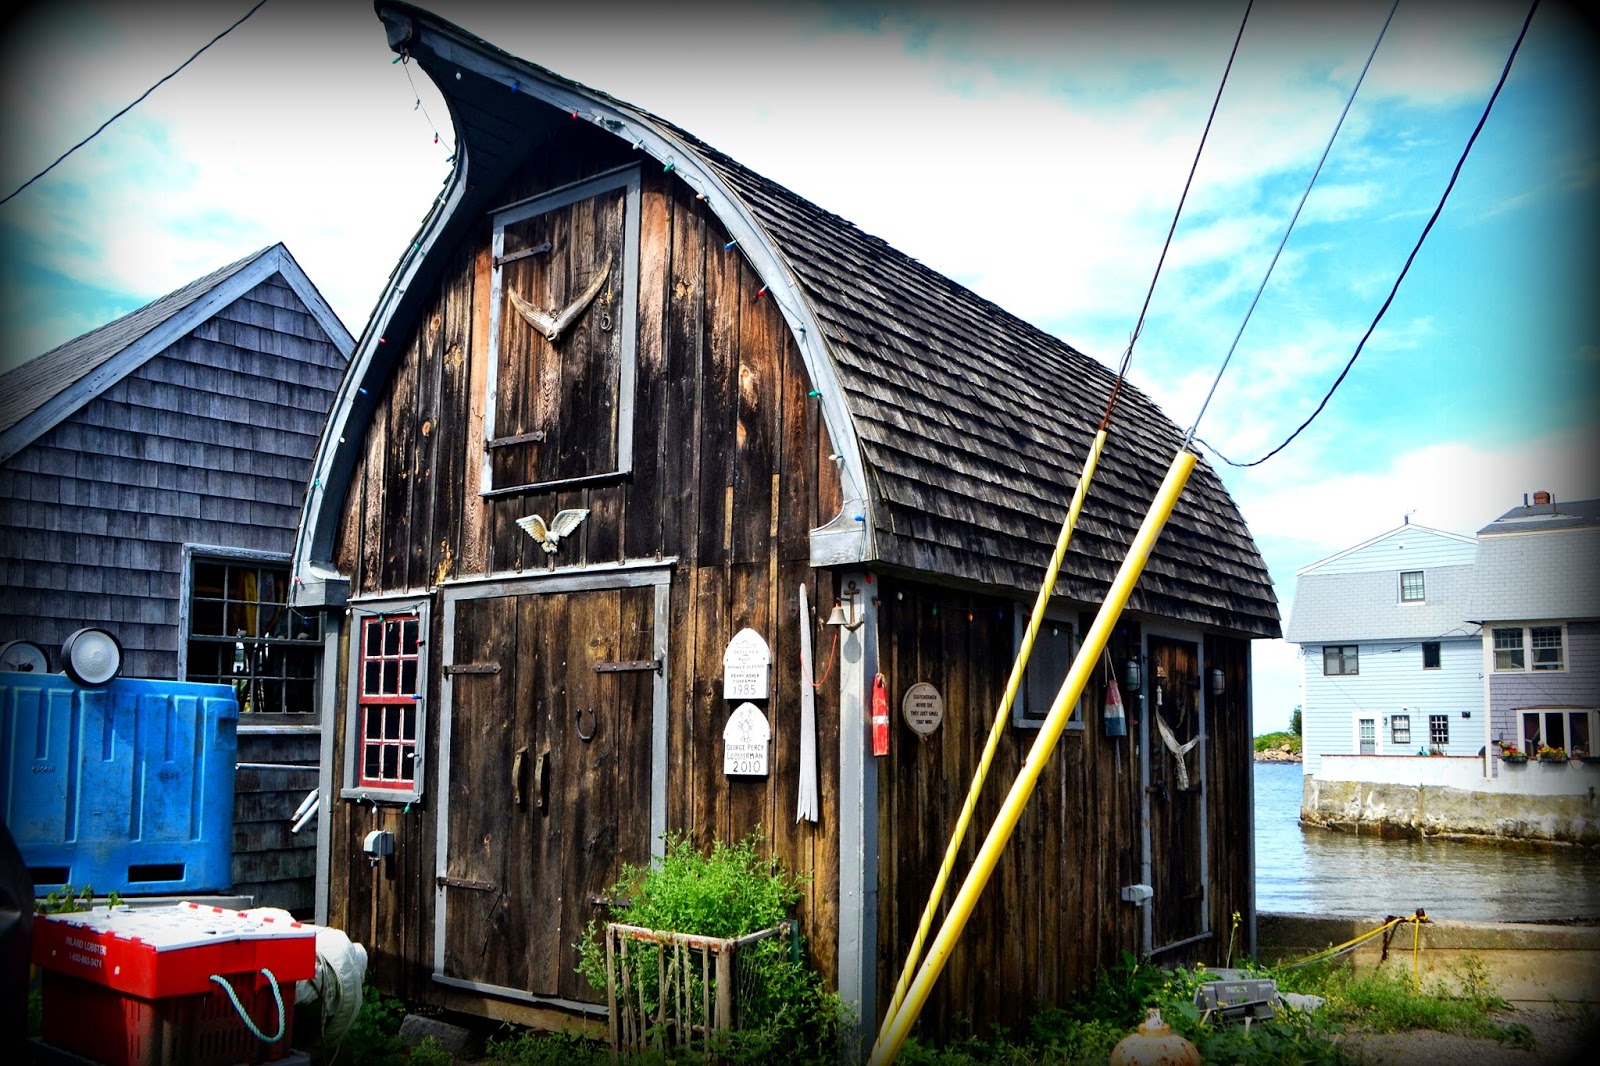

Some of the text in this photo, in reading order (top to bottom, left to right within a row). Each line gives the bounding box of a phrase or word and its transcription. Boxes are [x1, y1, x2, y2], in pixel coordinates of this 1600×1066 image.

[734, 684, 756, 695] 1985
[726, 752, 763, 760] LOBSTERMAN
[733, 760, 760, 772] 2010
[65, 936, 107, 956] INLAND LOBSTER
